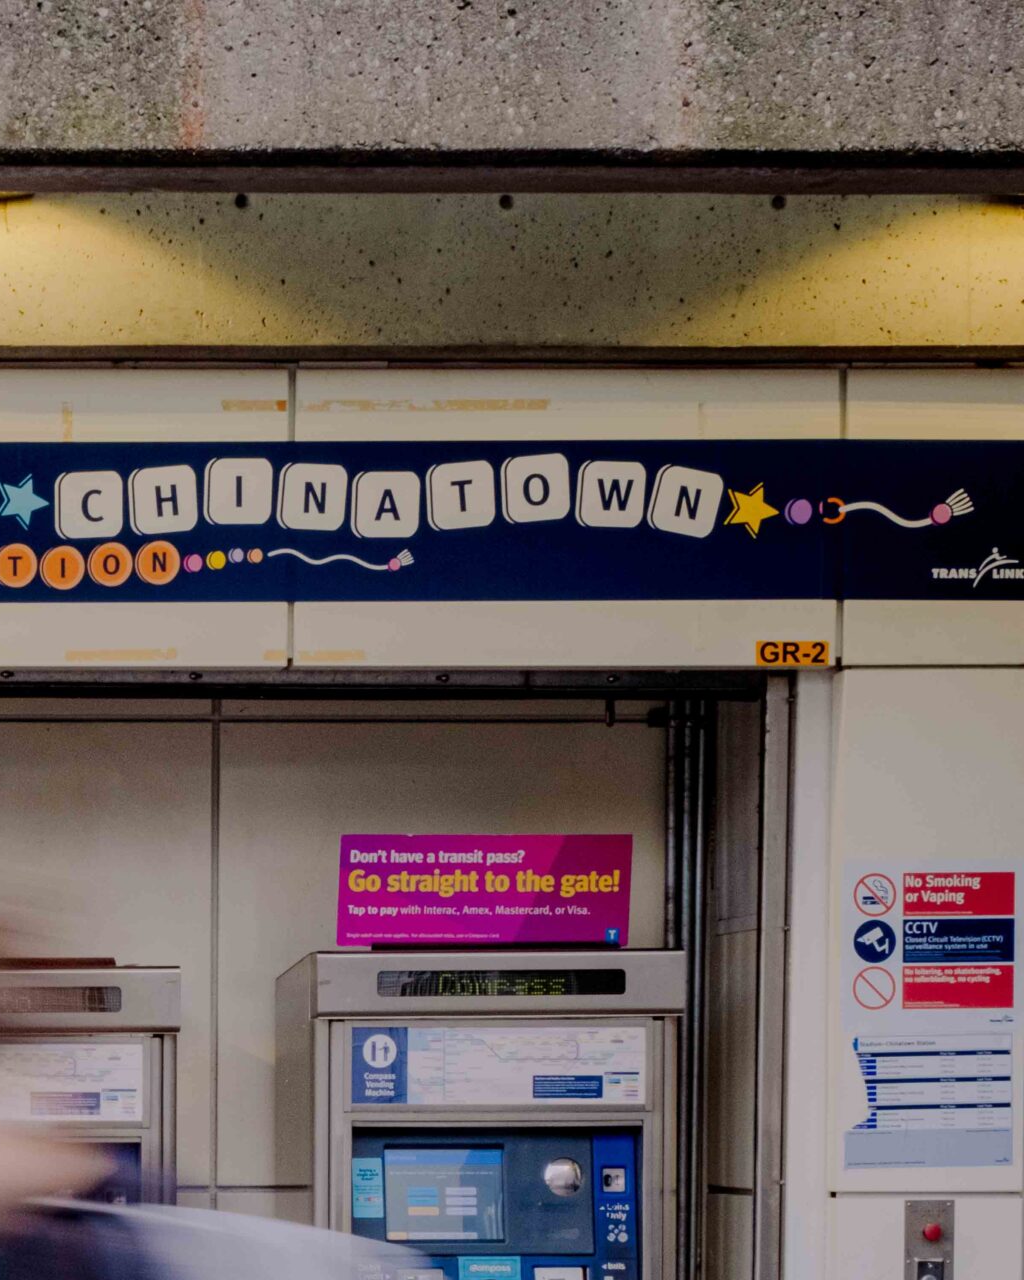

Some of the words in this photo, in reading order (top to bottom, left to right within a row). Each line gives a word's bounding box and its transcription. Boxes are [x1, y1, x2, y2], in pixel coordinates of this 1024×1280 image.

[81, 473, 703, 523] CHINATOWN
[759, 641, 826, 664] GR-2
[350, 849, 387, 864] Don't
[390, 849, 424, 864] have
[426, 852, 435, 864] a
[438, 849, 484, 864] transit
[487, 850, 526, 866] pass?
[348, 869, 382, 892] Go
[387, 868, 479, 898] straight
[485, 870, 510, 893] to
[516, 868, 555, 893] the
[560, 869, 620, 898] gate!
[905, 876, 922, 888] No
[926, 874, 981, 889] Smoking
[905, 892, 920, 903] or
[921, 889, 965, 905] Vaping
[348, 905, 366, 916] Tap
[367, 905, 378, 915] to
[379, 906, 399, 917] pay
[400, 905, 421, 915] with
[423, 905, 460, 916] Interac,
[462, 905, 493, 915] Amex,
[495, 905, 553, 915] Mastercard,
[554, 907, 565, 915] or
[567, 905, 591, 915] Visa.
[905, 921, 938, 934] CCTV
[905, 936, 926, 944] Closed
[949, 935, 981, 943] Television
[981, 935, 1004, 943] (CCTV)
[364, 1072, 396, 1081] Compass
[365, 1080, 395, 1089] Vending
